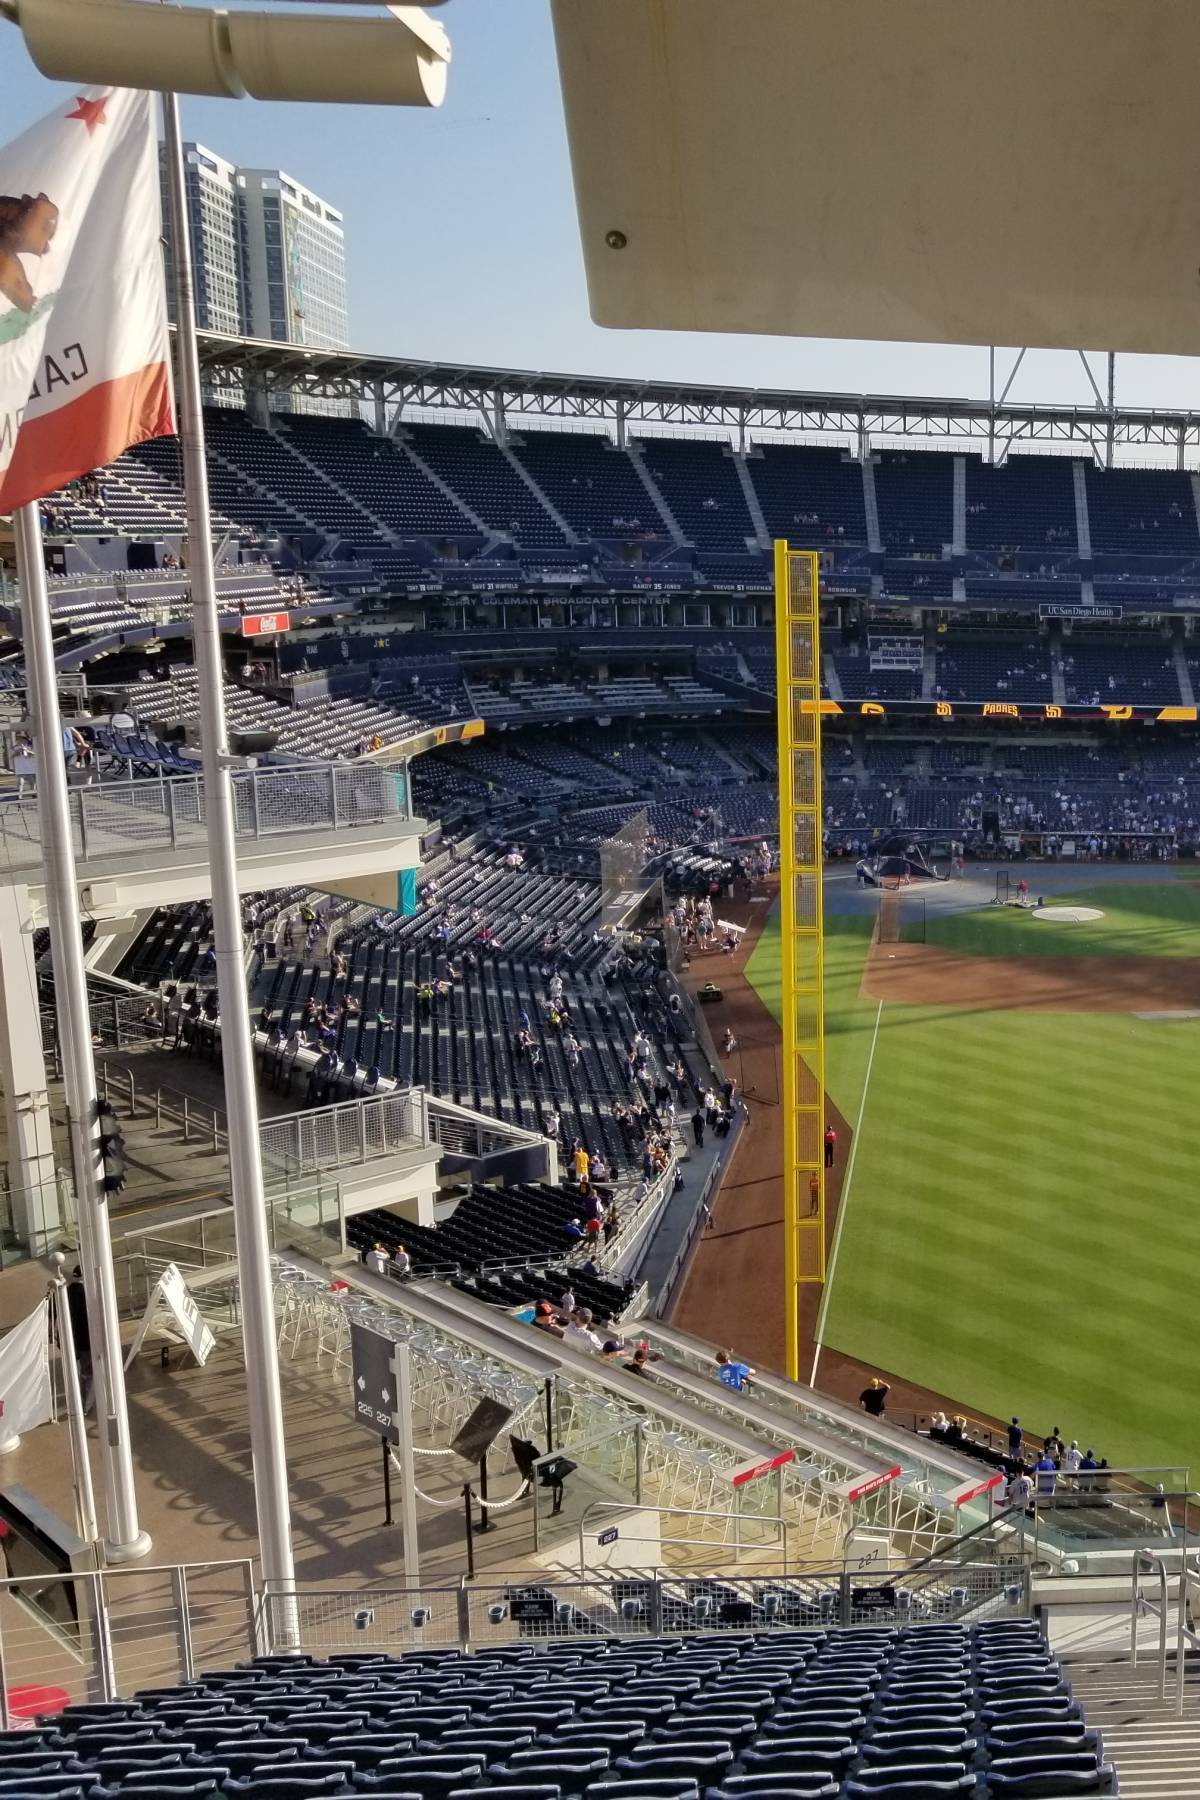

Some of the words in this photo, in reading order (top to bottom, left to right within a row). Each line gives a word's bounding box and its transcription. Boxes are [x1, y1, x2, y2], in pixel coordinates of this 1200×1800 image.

[482, 597, 539, 605] COLEMAN
[543, 596, 617, 605] BROADCAST
[622, 596, 671, 605] CENTER
[982, 703, 1018, 718] PADRES
[357, 1400, 374, 1419] 225
[376, 1411, 392, 1428] 227
[603, 1531, 617, 1544] 227
[858, 1549, 879, 1569] 227
